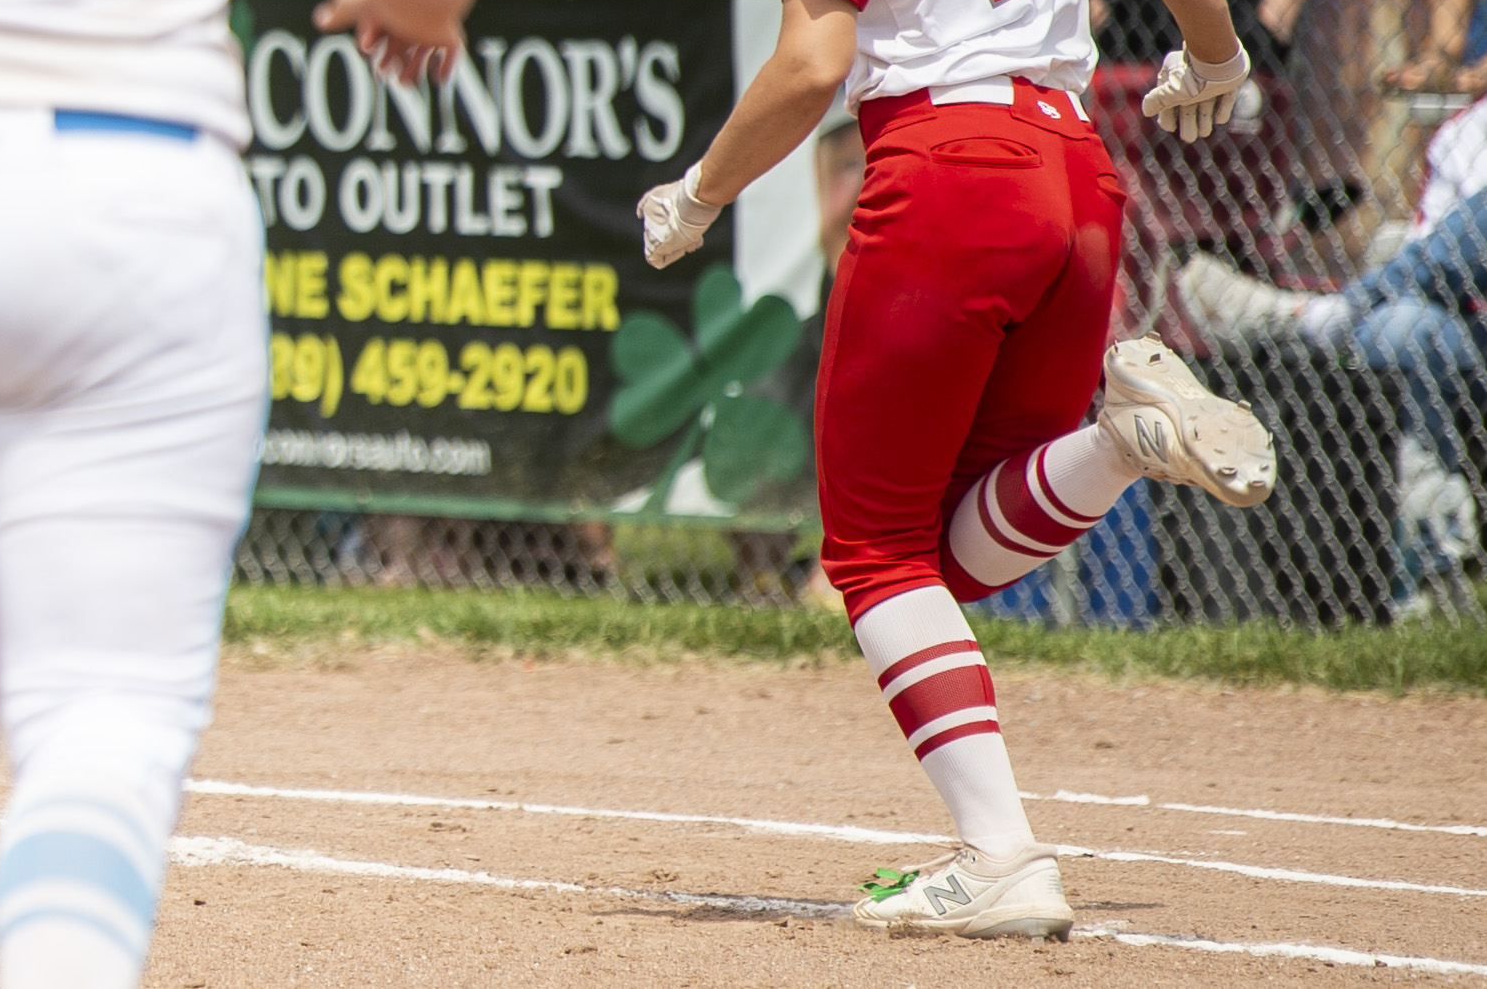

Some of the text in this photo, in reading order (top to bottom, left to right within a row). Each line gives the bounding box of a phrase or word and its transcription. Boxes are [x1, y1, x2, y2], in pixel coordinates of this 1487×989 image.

[248, 29, 685, 162] CONNOR'S
[339, 157, 564, 238] OUTLET
[338, 252, 621, 332] SCHAEFER
[351, 336, 589, 416] 459-2920
